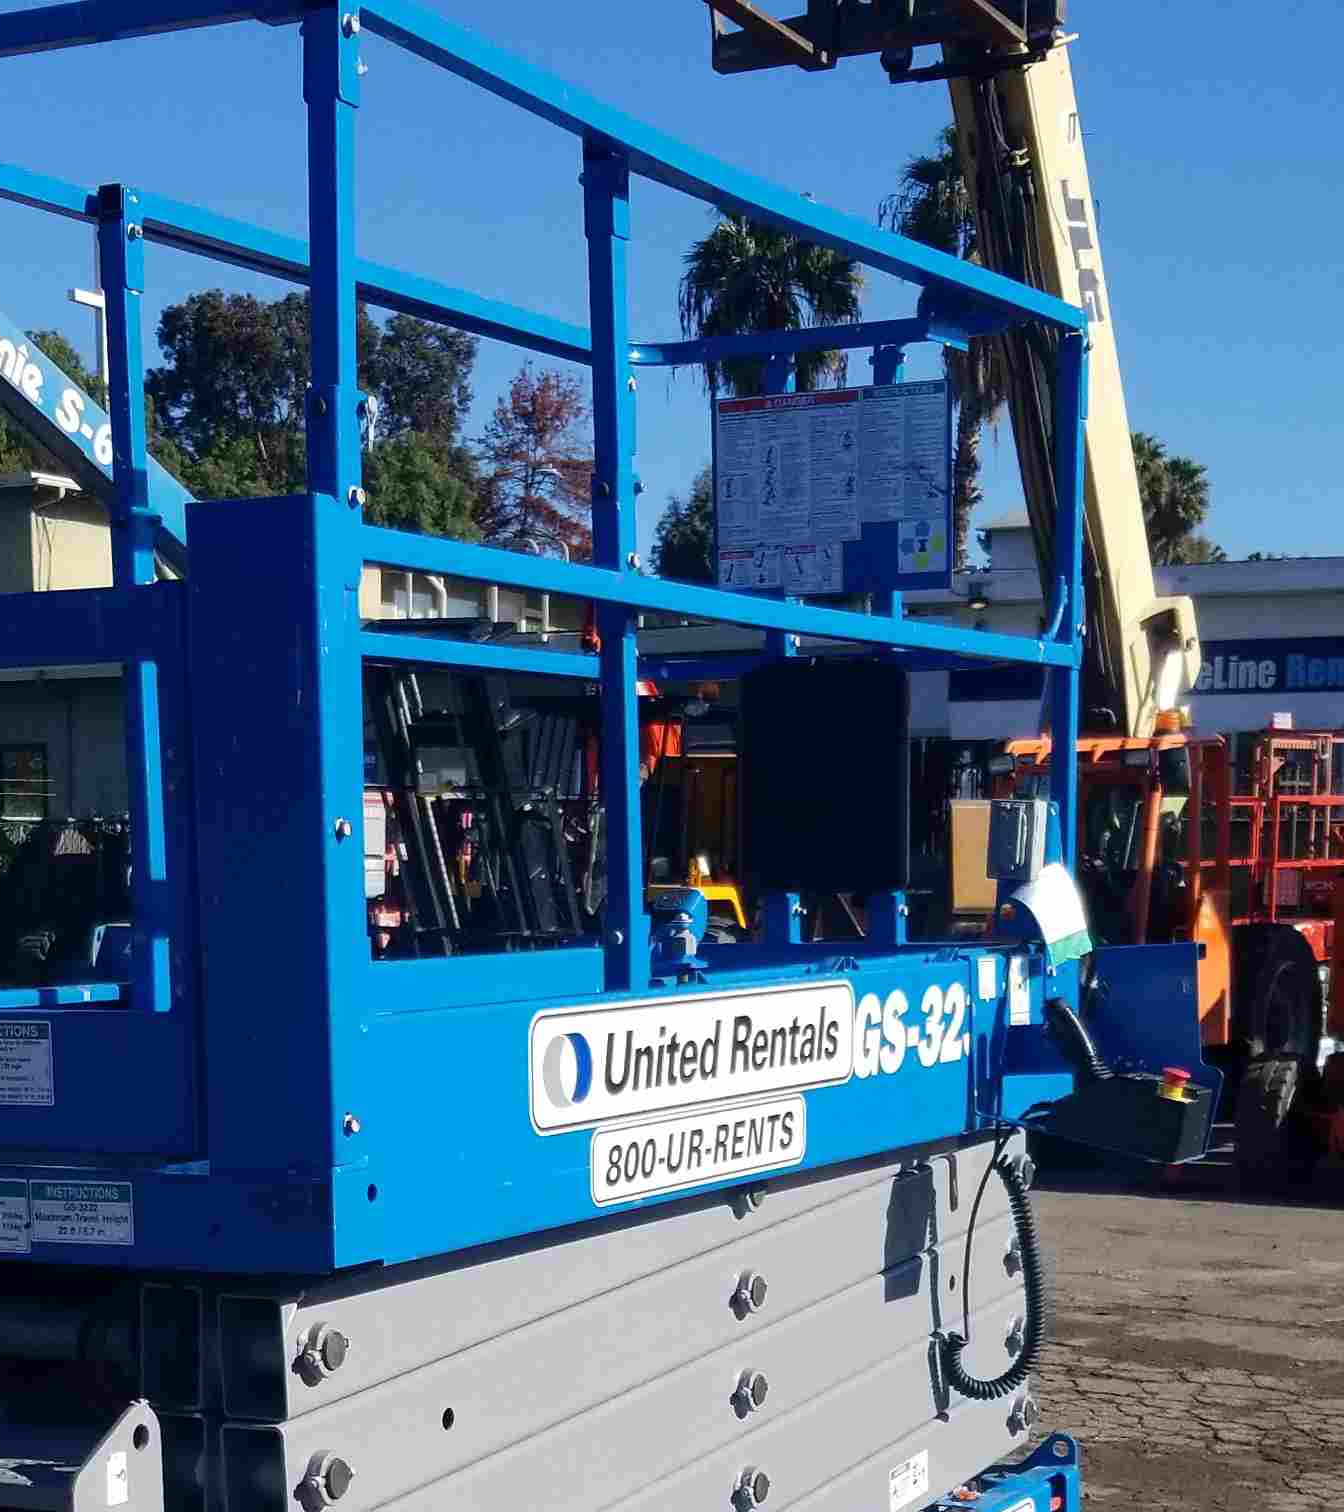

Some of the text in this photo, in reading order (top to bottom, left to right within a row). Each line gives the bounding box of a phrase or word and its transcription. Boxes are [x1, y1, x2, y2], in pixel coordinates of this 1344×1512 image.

[604, 1005, 840, 1095] United Rentals
[854, 982, 970, 1079] GS-32
[605, 1111, 795, 1187] 800-UR-RENTS
